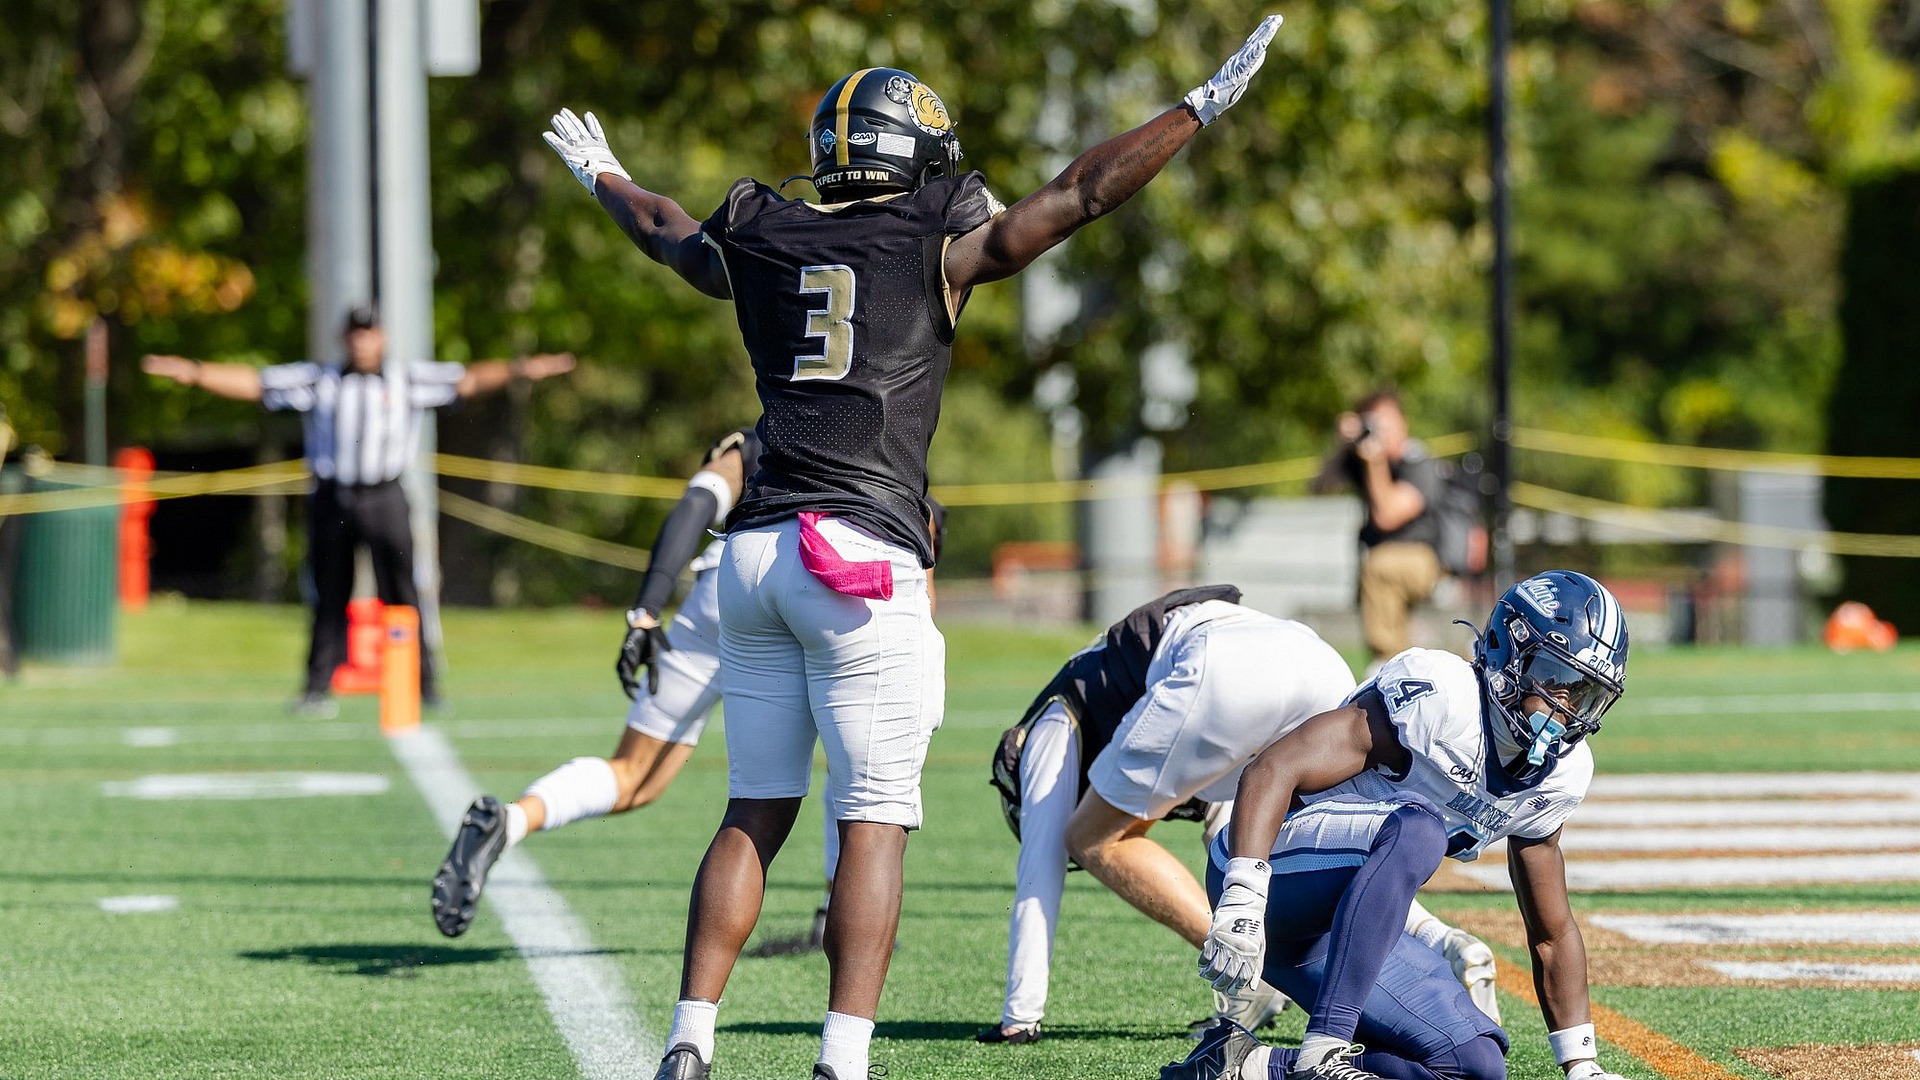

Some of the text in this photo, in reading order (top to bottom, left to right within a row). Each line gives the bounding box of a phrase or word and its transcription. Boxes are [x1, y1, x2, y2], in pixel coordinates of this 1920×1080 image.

[851, 132, 874, 142] CAA
[815, 170, 889, 188] EXPECT TO WIN
[790, 264, 856, 382] 3
[1516, 578, 1561, 618] Maine
[1391, 679, 1436, 713] 4
[1449, 764, 1476, 780] CAA
[1446, 791, 1513, 832] MAINE
